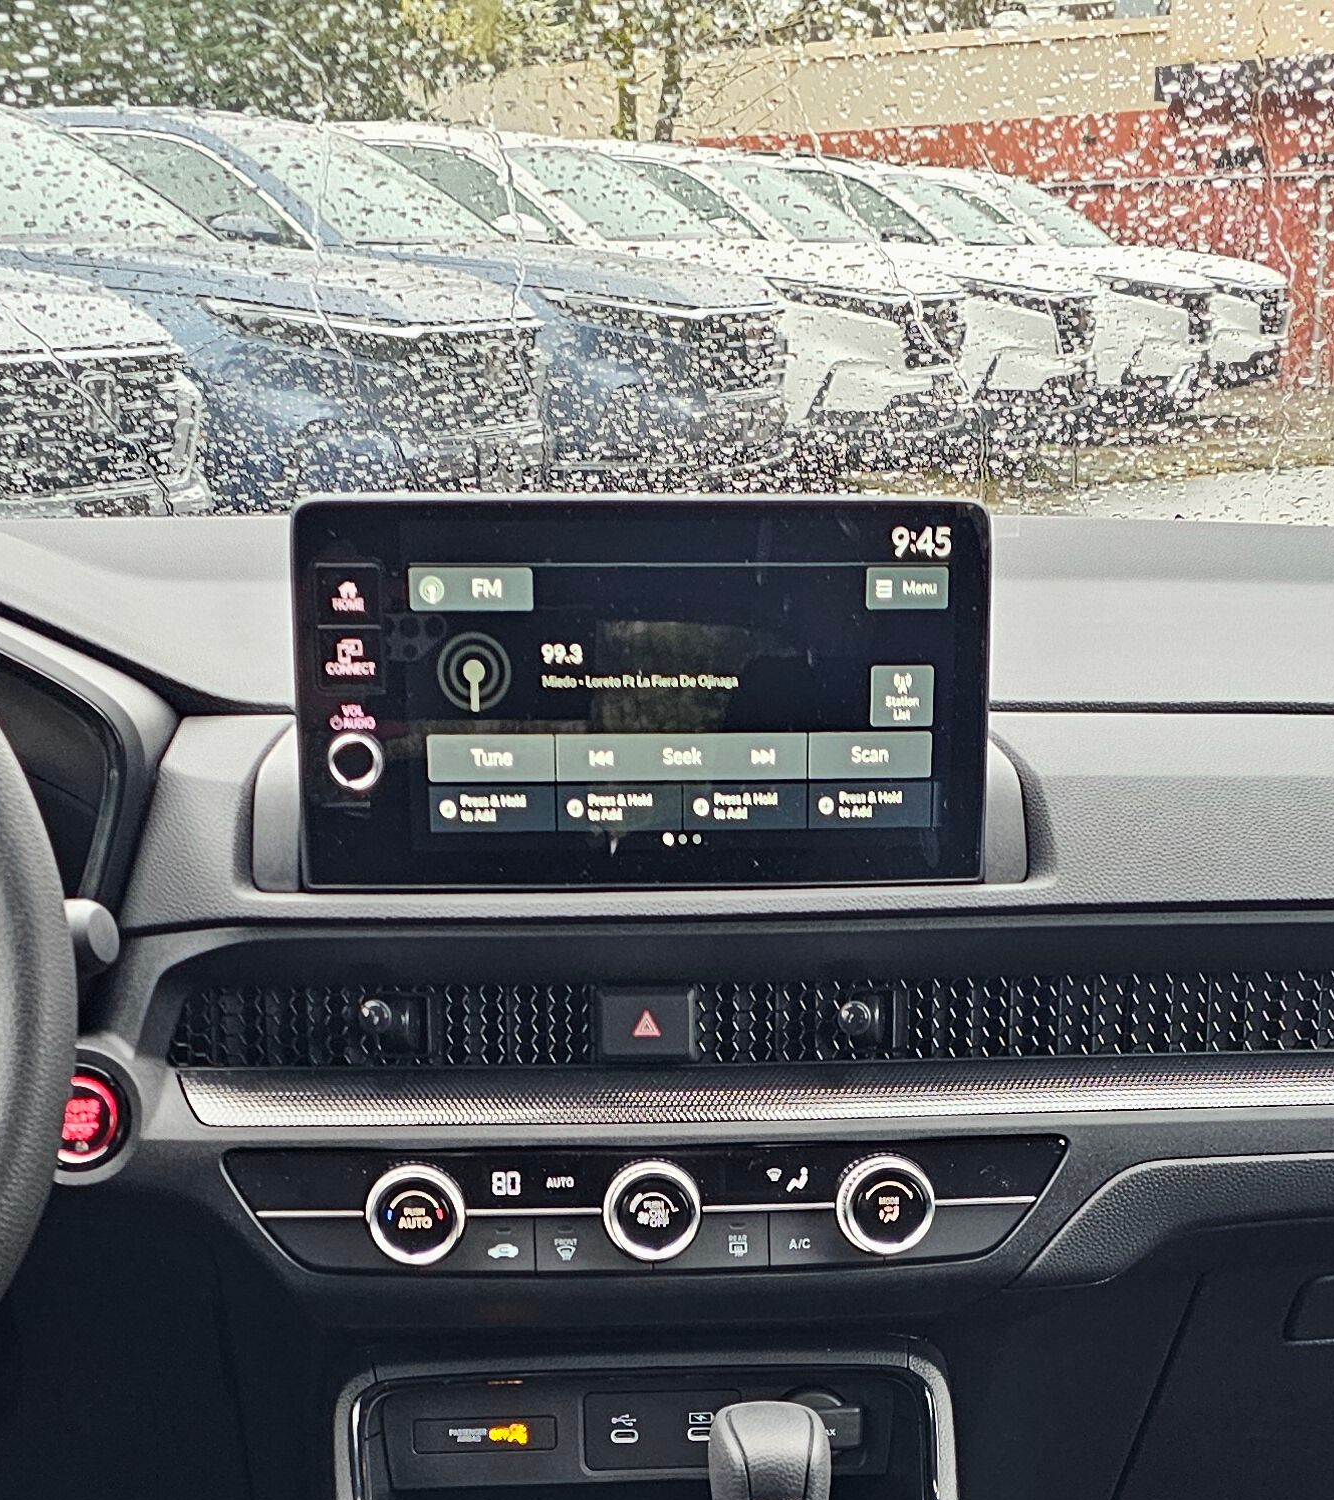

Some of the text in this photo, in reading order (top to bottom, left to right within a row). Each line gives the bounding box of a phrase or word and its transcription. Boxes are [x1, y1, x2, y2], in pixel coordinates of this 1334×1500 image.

[891, 526, 952, 558] 9:45
[471, 578, 502, 598] FM
[902, 580, 938, 596] Menu
[331, 598, 366, 612] HOME
[541, 643, 584, 665] 99.3
[324, 661, 377, 676] CONNECT
[885, 696, 920, 708] Station
[340, 704, 364, 717] VOL
[893, 709, 911, 721] List
[344, 716, 376, 730] AUDIO
[470, 748, 514, 767] Tune
[662, 747, 703, 766] Seek
[851, 745, 890, 764] Scan
[459, 794, 489, 808] Press
[500, 794, 527, 808] Hold
[587, 793, 616, 807] Press
[627, 793, 653, 807] Hold
[713, 792, 742, 806] Press
[753, 792, 778, 806] Hold
[838, 791, 867, 805] Press
[877, 791, 903, 805] Hold
[491, 1171, 521, 1196] 80
[546, 1176, 575, 1189] AUTO
[398, 1217, 433, 1229] AUTO
[554, 1238, 578, 1247] FRONT
[728, 1234, 748, 1242] REAR
[788, 1238, 811, 1250] A/C
